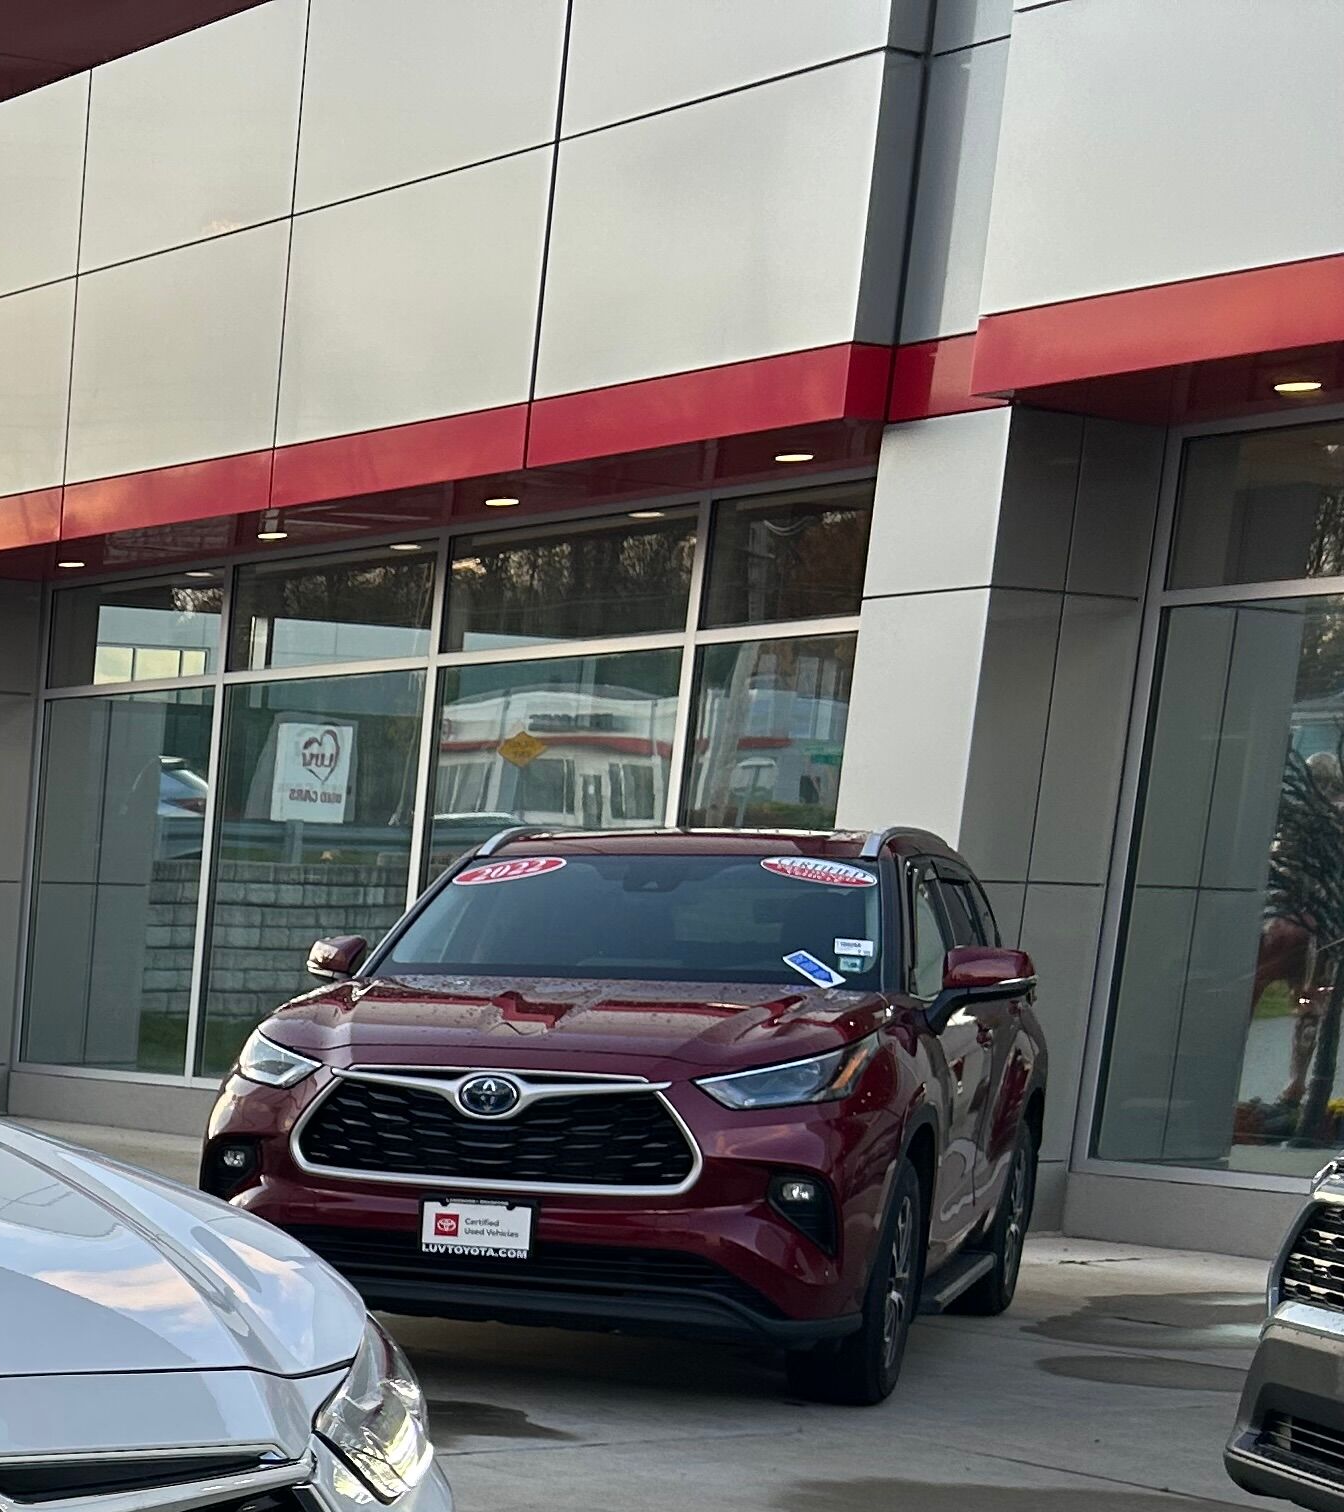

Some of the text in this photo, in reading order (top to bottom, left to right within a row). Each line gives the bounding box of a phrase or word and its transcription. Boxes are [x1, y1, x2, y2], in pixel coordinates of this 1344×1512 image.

[472, 859, 547, 881] 2022
[464, 1217, 500, 1227] Certified
[464, 1228, 519, 1238] Used Vehicles
[421, 1244, 528, 1260] LUVTOYOTA.COM
